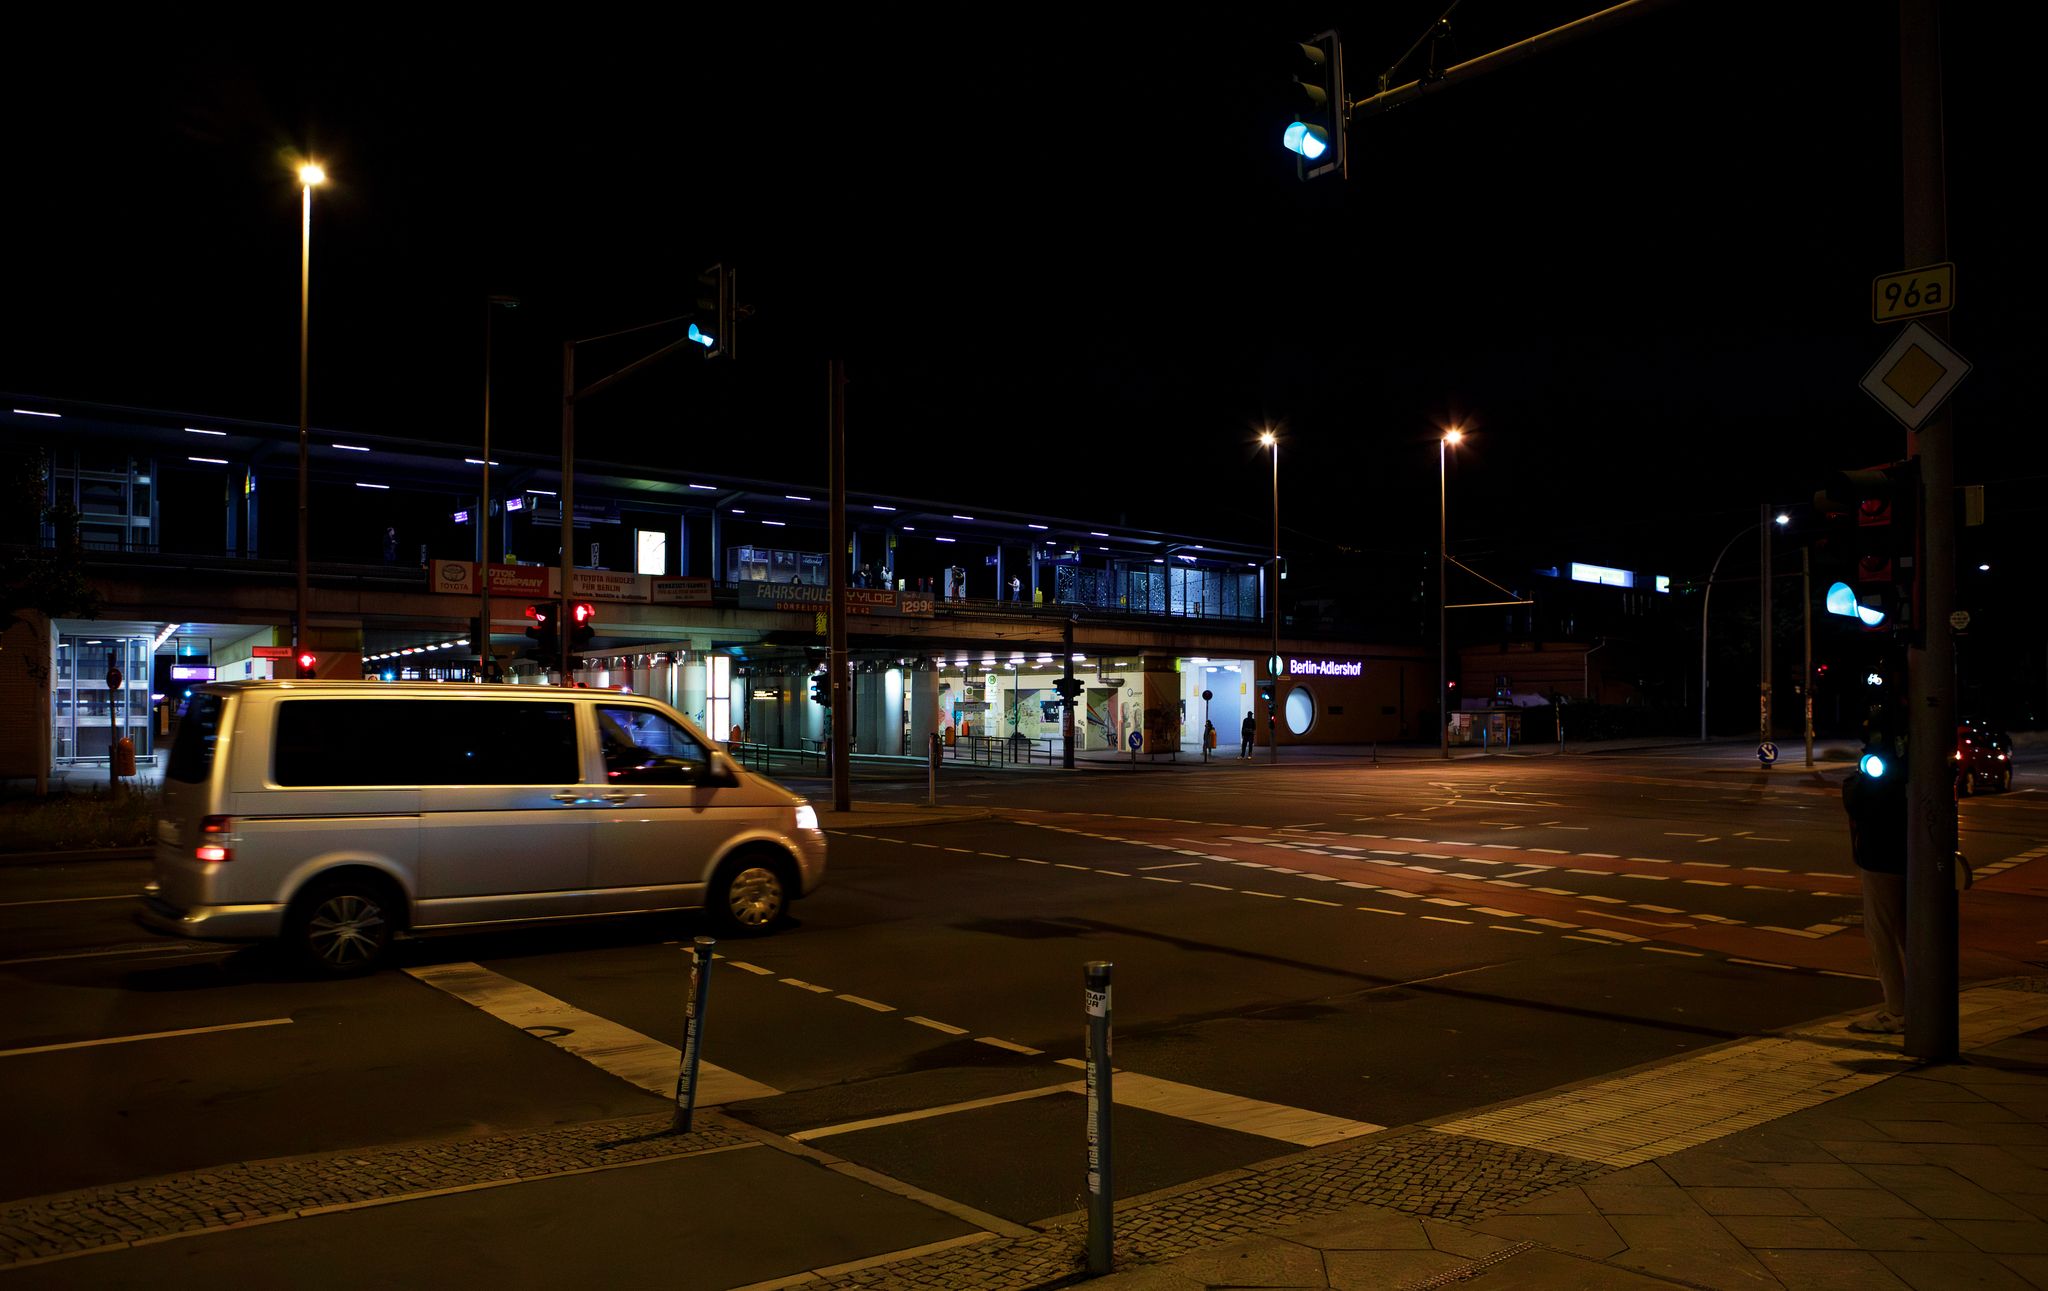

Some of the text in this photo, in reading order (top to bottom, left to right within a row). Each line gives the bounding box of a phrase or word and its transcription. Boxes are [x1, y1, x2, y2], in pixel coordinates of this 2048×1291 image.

[1885, 278, 1942, 312] 96a
[440, 582, 469, 591] TOYOTA
[1289, 659, 1361, 676] Berlin-Adlershof
